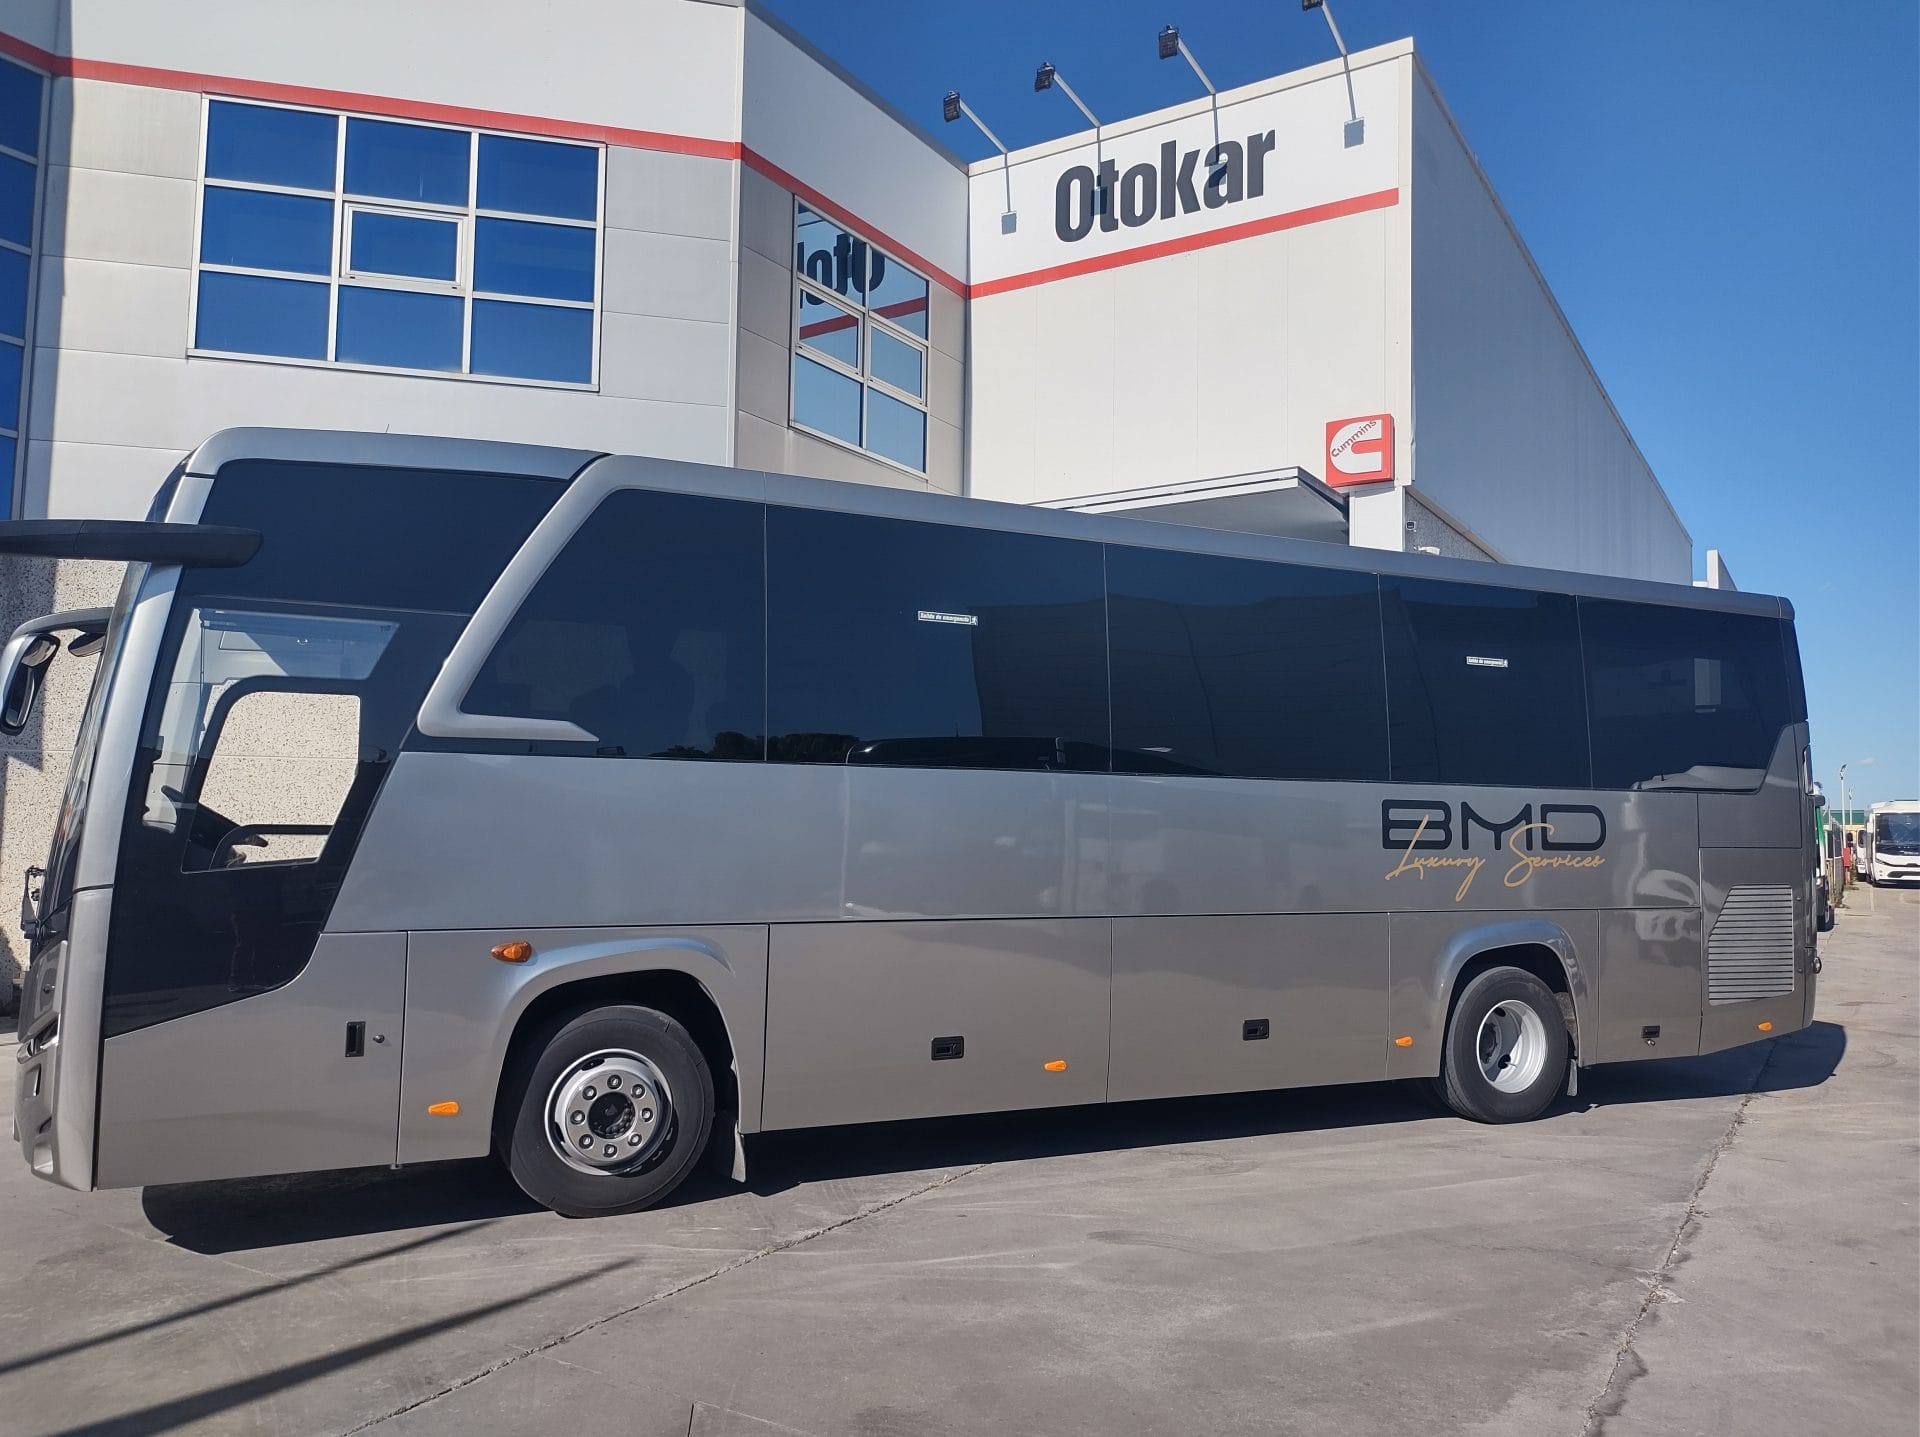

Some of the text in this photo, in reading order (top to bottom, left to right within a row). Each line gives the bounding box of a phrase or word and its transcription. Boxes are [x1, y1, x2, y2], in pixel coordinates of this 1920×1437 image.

[1055, 129, 1276, 243] Otokar
[1331, 421, 1377, 457] Cummins
[1382, 799, 1607, 851] BMD
[1385, 814, 1605, 902] Luxury Services
